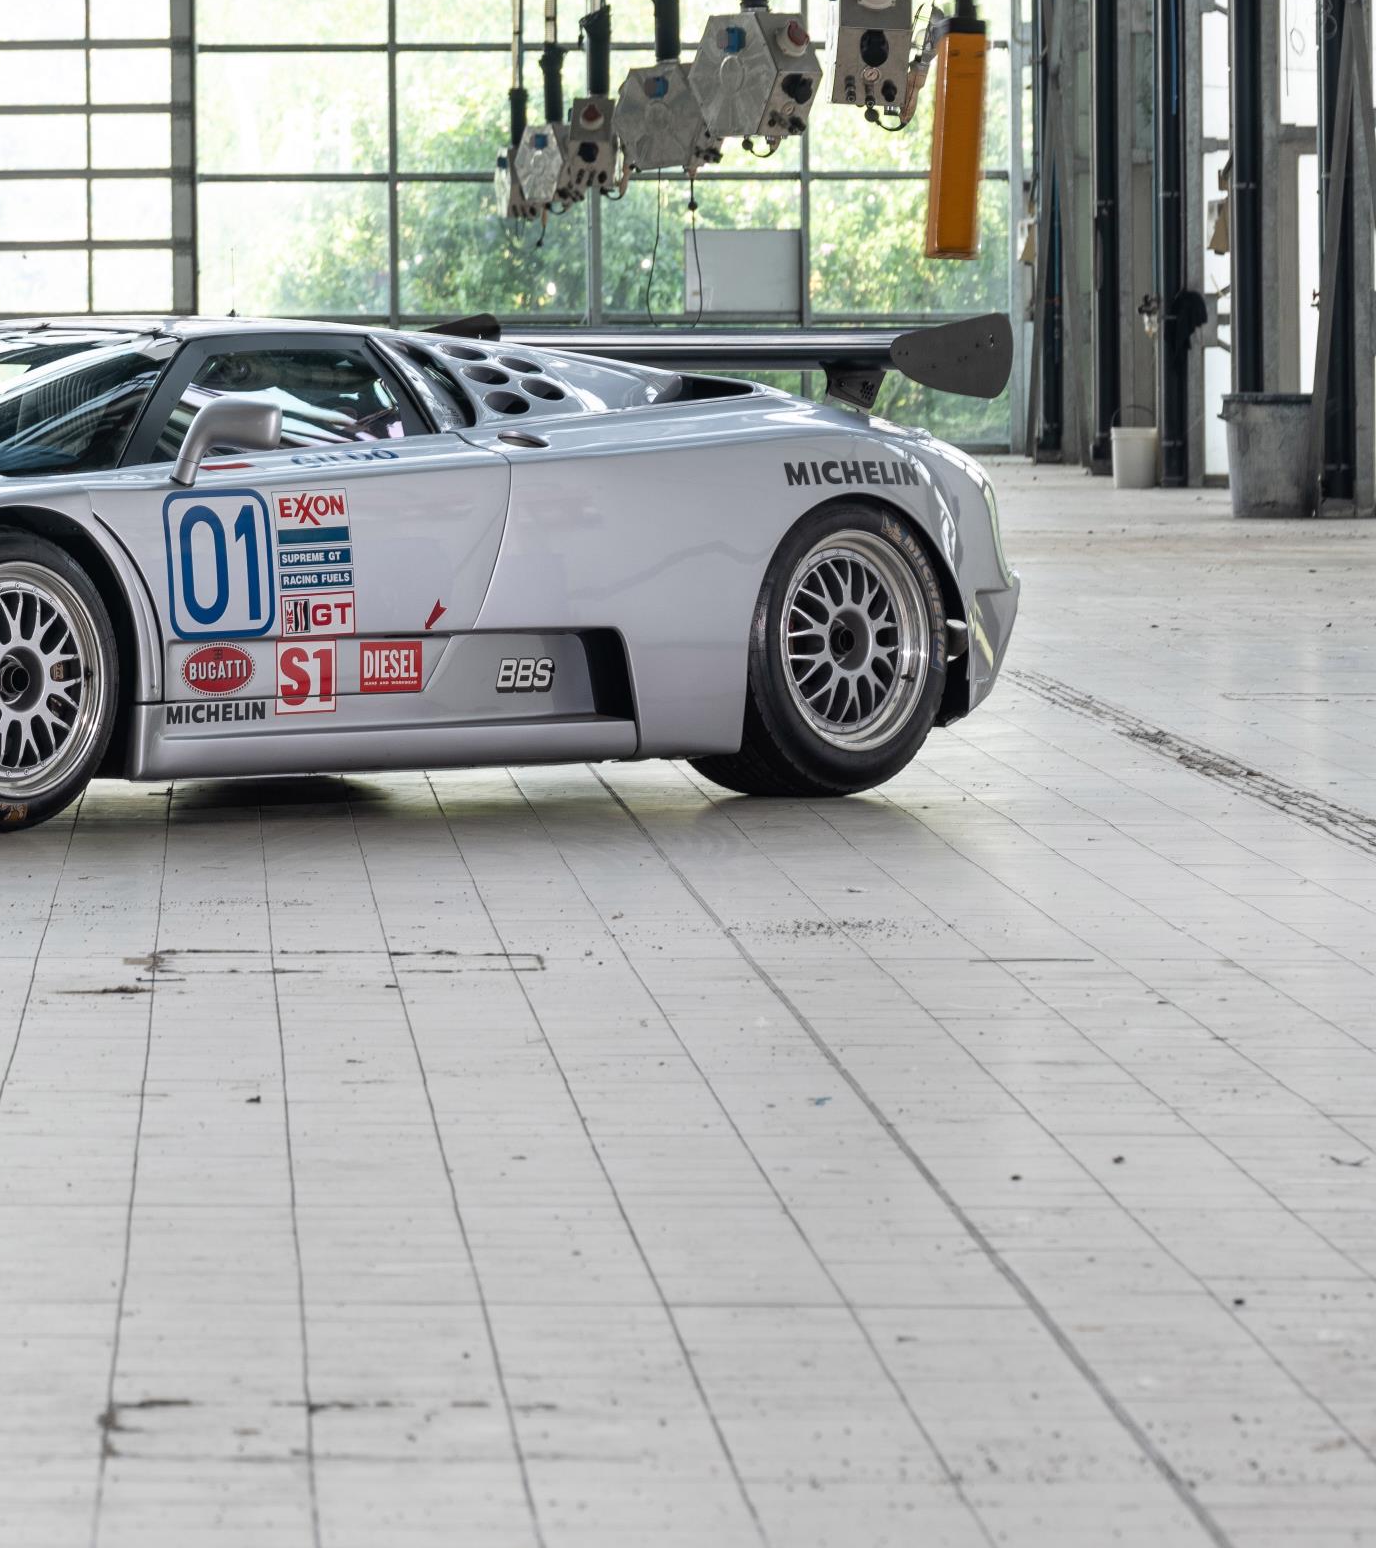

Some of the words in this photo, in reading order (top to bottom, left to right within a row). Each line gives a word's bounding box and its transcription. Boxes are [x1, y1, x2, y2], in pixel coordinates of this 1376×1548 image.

[784, 461, 919, 486] MICHELIN
[278, 492, 345, 526] EXXON
[179, 504, 262, 625] 01
[282, 553, 325, 564] SUPREME
[328, 552, 341, 561] GT
[283, 574, 319, 586] RACING
[321, 572, 350, 583] FUELS
[311, 602, 352, 627] GT
[189, 659, 247, 681] BUGATTI
[363, 649, 418, 679] DIESEL
[495, 657, 555, 693] BBS
[279, 647, 333, 707] S1
[165, 701, 266, 725] MICHELIN
